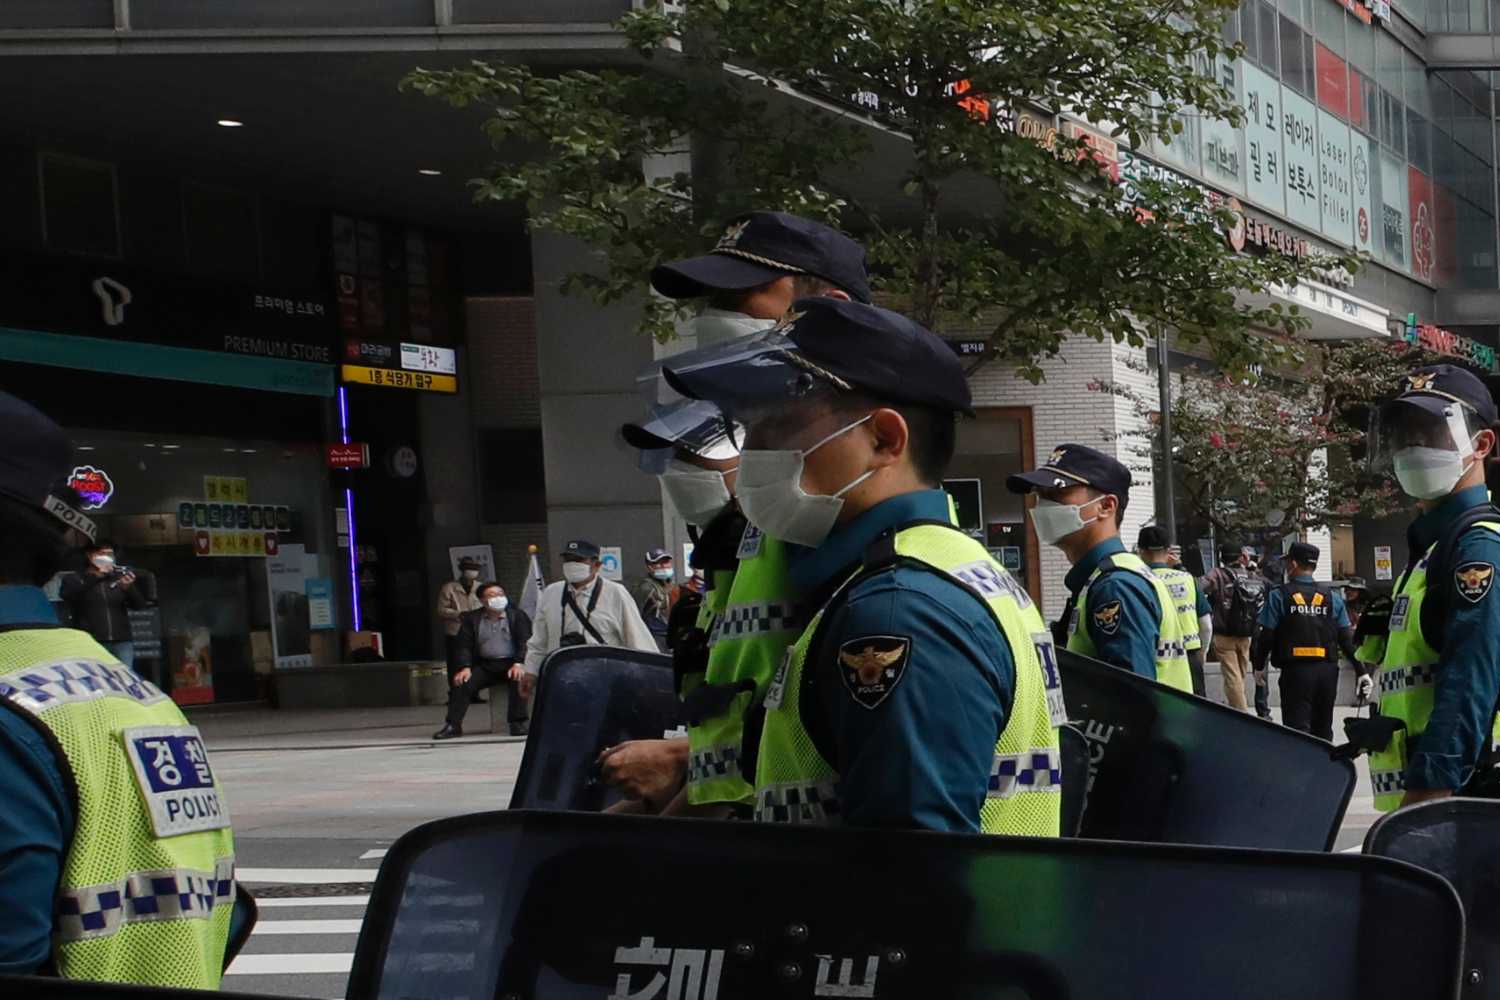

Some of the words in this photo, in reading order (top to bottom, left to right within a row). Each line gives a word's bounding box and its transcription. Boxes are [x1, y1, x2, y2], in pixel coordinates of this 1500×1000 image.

[1285, 113, 1314, 156] 레이저
[1320, 132, 1347, 165] Laser
[1288, 162, 1316, 204] 보톡스
[1322, 164, 1348, 195] Botox
[1323, 194, 1349, 224] Filler
[223, 335, 288, 356] PREMIUM
[291, 344, 329, 361] STORE
[1289, 605, 1328, 616] POLICE
[857, 684, 886, 694] POLICE
